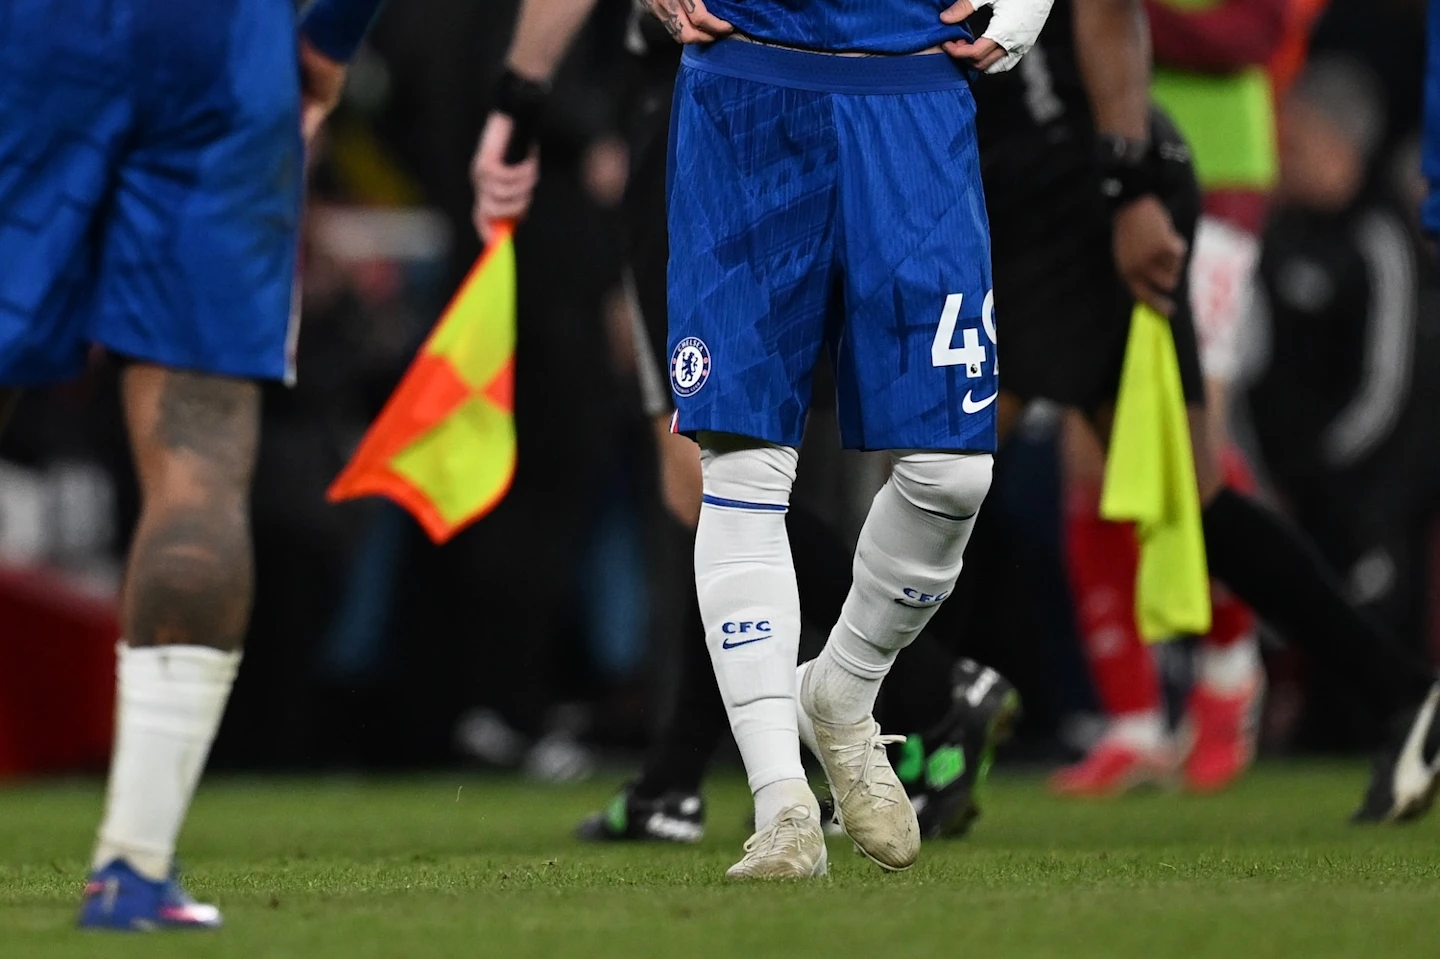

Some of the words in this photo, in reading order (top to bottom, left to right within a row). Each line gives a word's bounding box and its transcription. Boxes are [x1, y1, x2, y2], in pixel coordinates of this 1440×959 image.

[677, 339, 704, 353] CHELSEA
[903, 587, 949, 603] CFC
[721, 620, 772, 635] CFC
